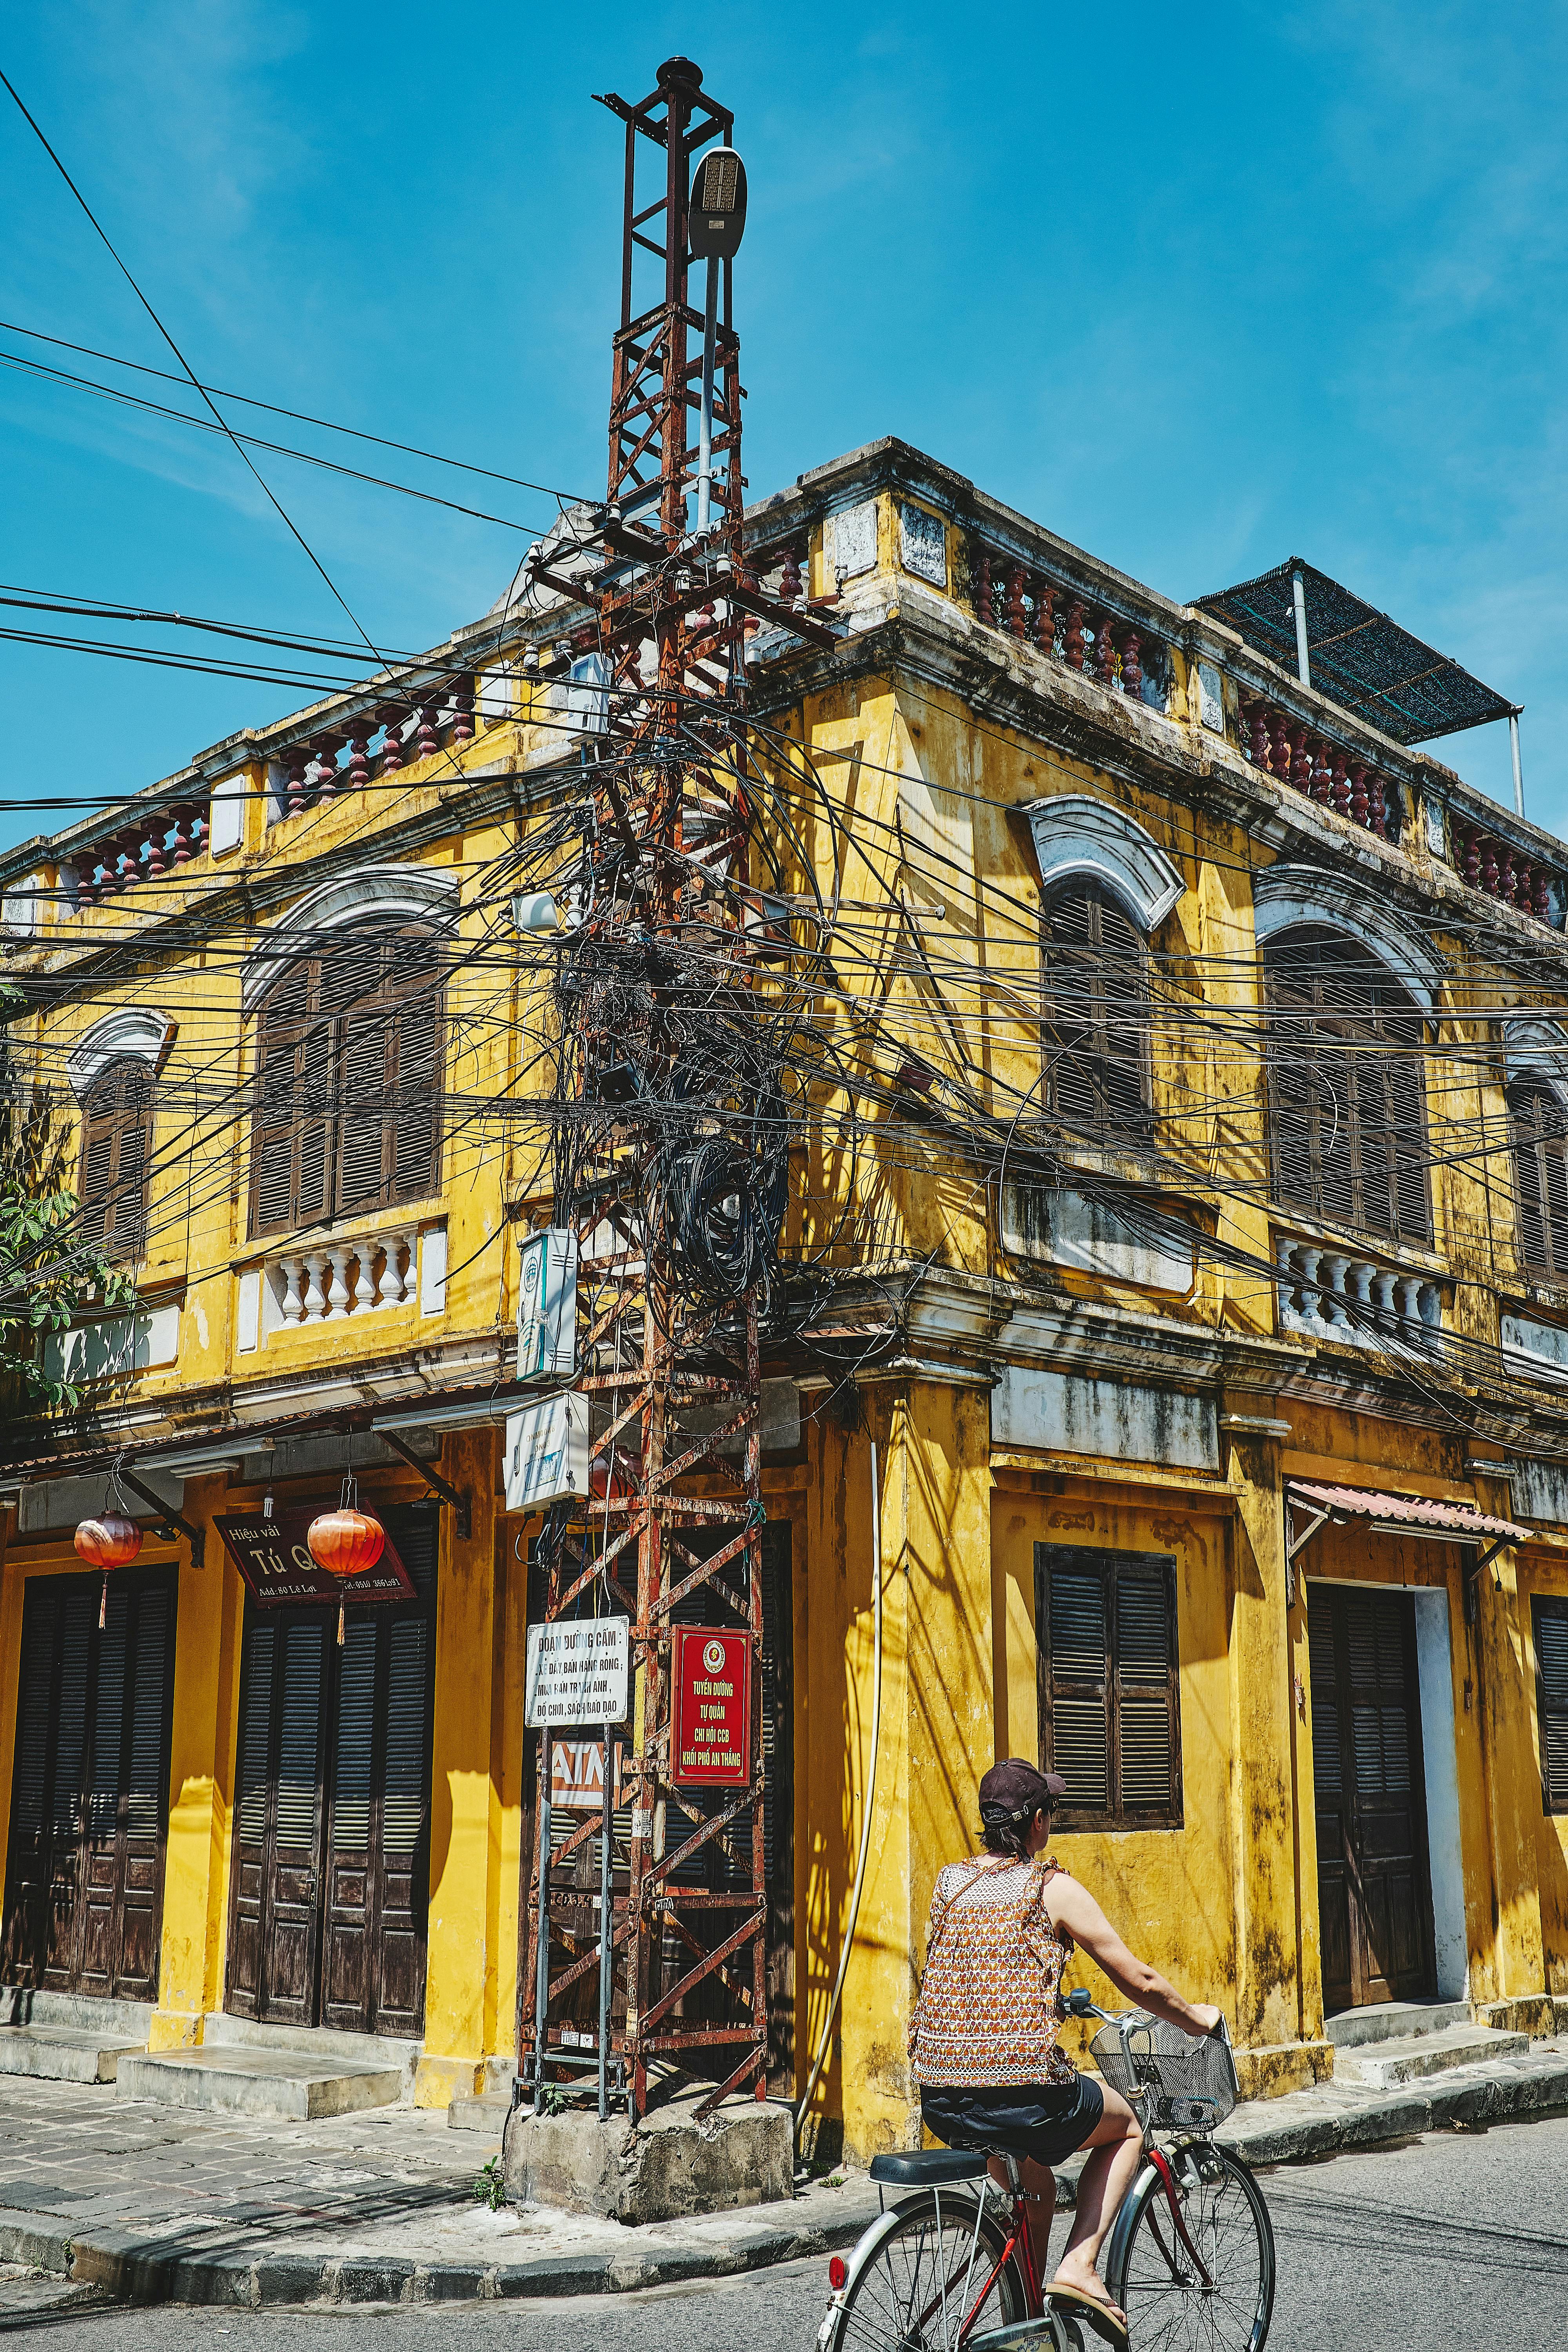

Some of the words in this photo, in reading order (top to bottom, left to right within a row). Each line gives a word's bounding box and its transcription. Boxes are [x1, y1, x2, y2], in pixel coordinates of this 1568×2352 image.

[229, 1528, 259, 1542] Hiệu
[260, 1524, 281, 1537] vải
[250, 1548, 287, 1574] Tú
[539, 1636, 561, 1655] ĐOẠN
[564, 1630, 593, 1650] ĐƯỜNG
[564, 1659, 577, 1673] BÁN
[693, 1678, 712, 1695] TUYẾN
[713, 1679, 733, 1697] ĐƯỜNG
[568, 1700, 585, 1715] SÁCH
[587, 1699, 601, 1713] BÁO
[603, 1700, 617, 1715] DẠO
[700, 1704, 708, 1721] TỰ
[709, 1701, 725, 1720] QUẢN
[694, 1728, 704, 1742] CHI
[706, 1726, 716, 1745] HỘI
[717, 1728, 729, 1742] CCB
[552, 1744, 620, 1786] ATM
[682, 1746, 697, 1766] KHỐI
[698, 1748, 710, 1766] PHỐ
[711, 1752, 720, 1766] AN
[721, 1748, 740, 1767] THẮNG
[656, 1898, 672, 1911] GUIDO
